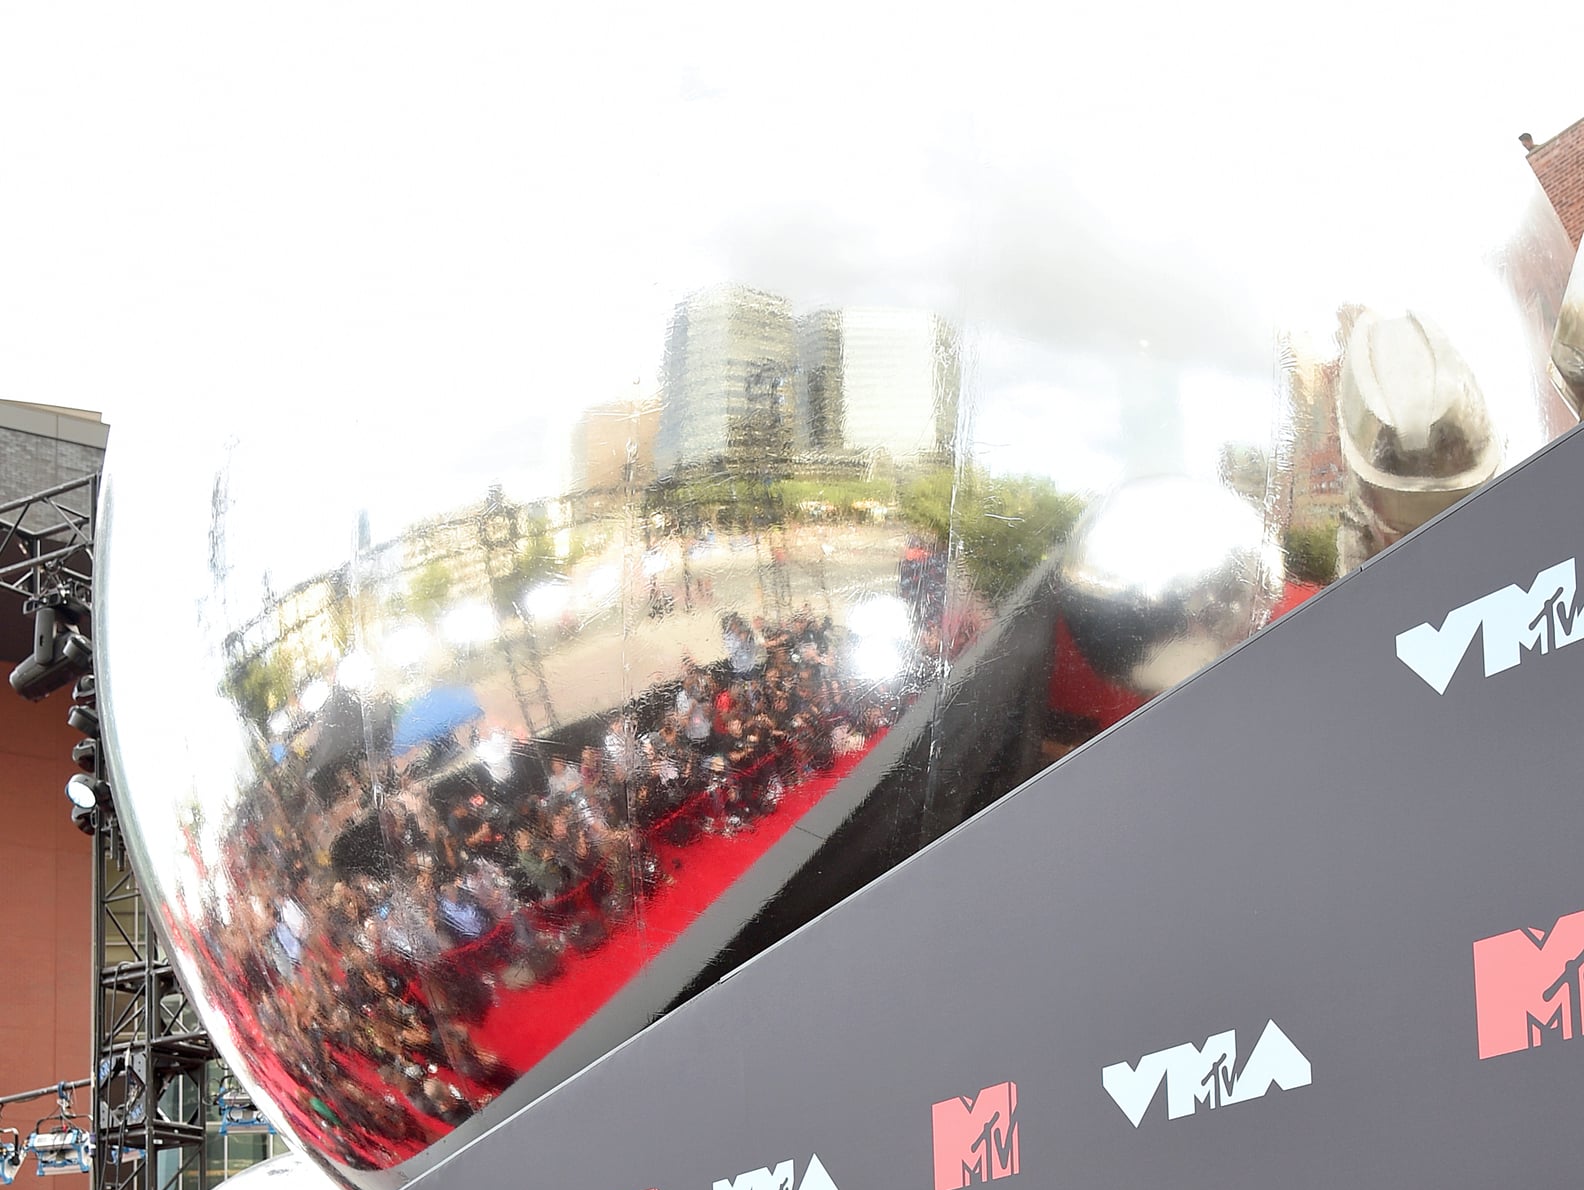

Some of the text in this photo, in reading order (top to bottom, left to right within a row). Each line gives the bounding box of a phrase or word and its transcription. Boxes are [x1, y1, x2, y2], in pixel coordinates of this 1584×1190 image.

[1396, 558, 1584, 695] VM
[1473, 911, 1584, 1058] MT
[1103, 1019, 1312, 1128] VMA
